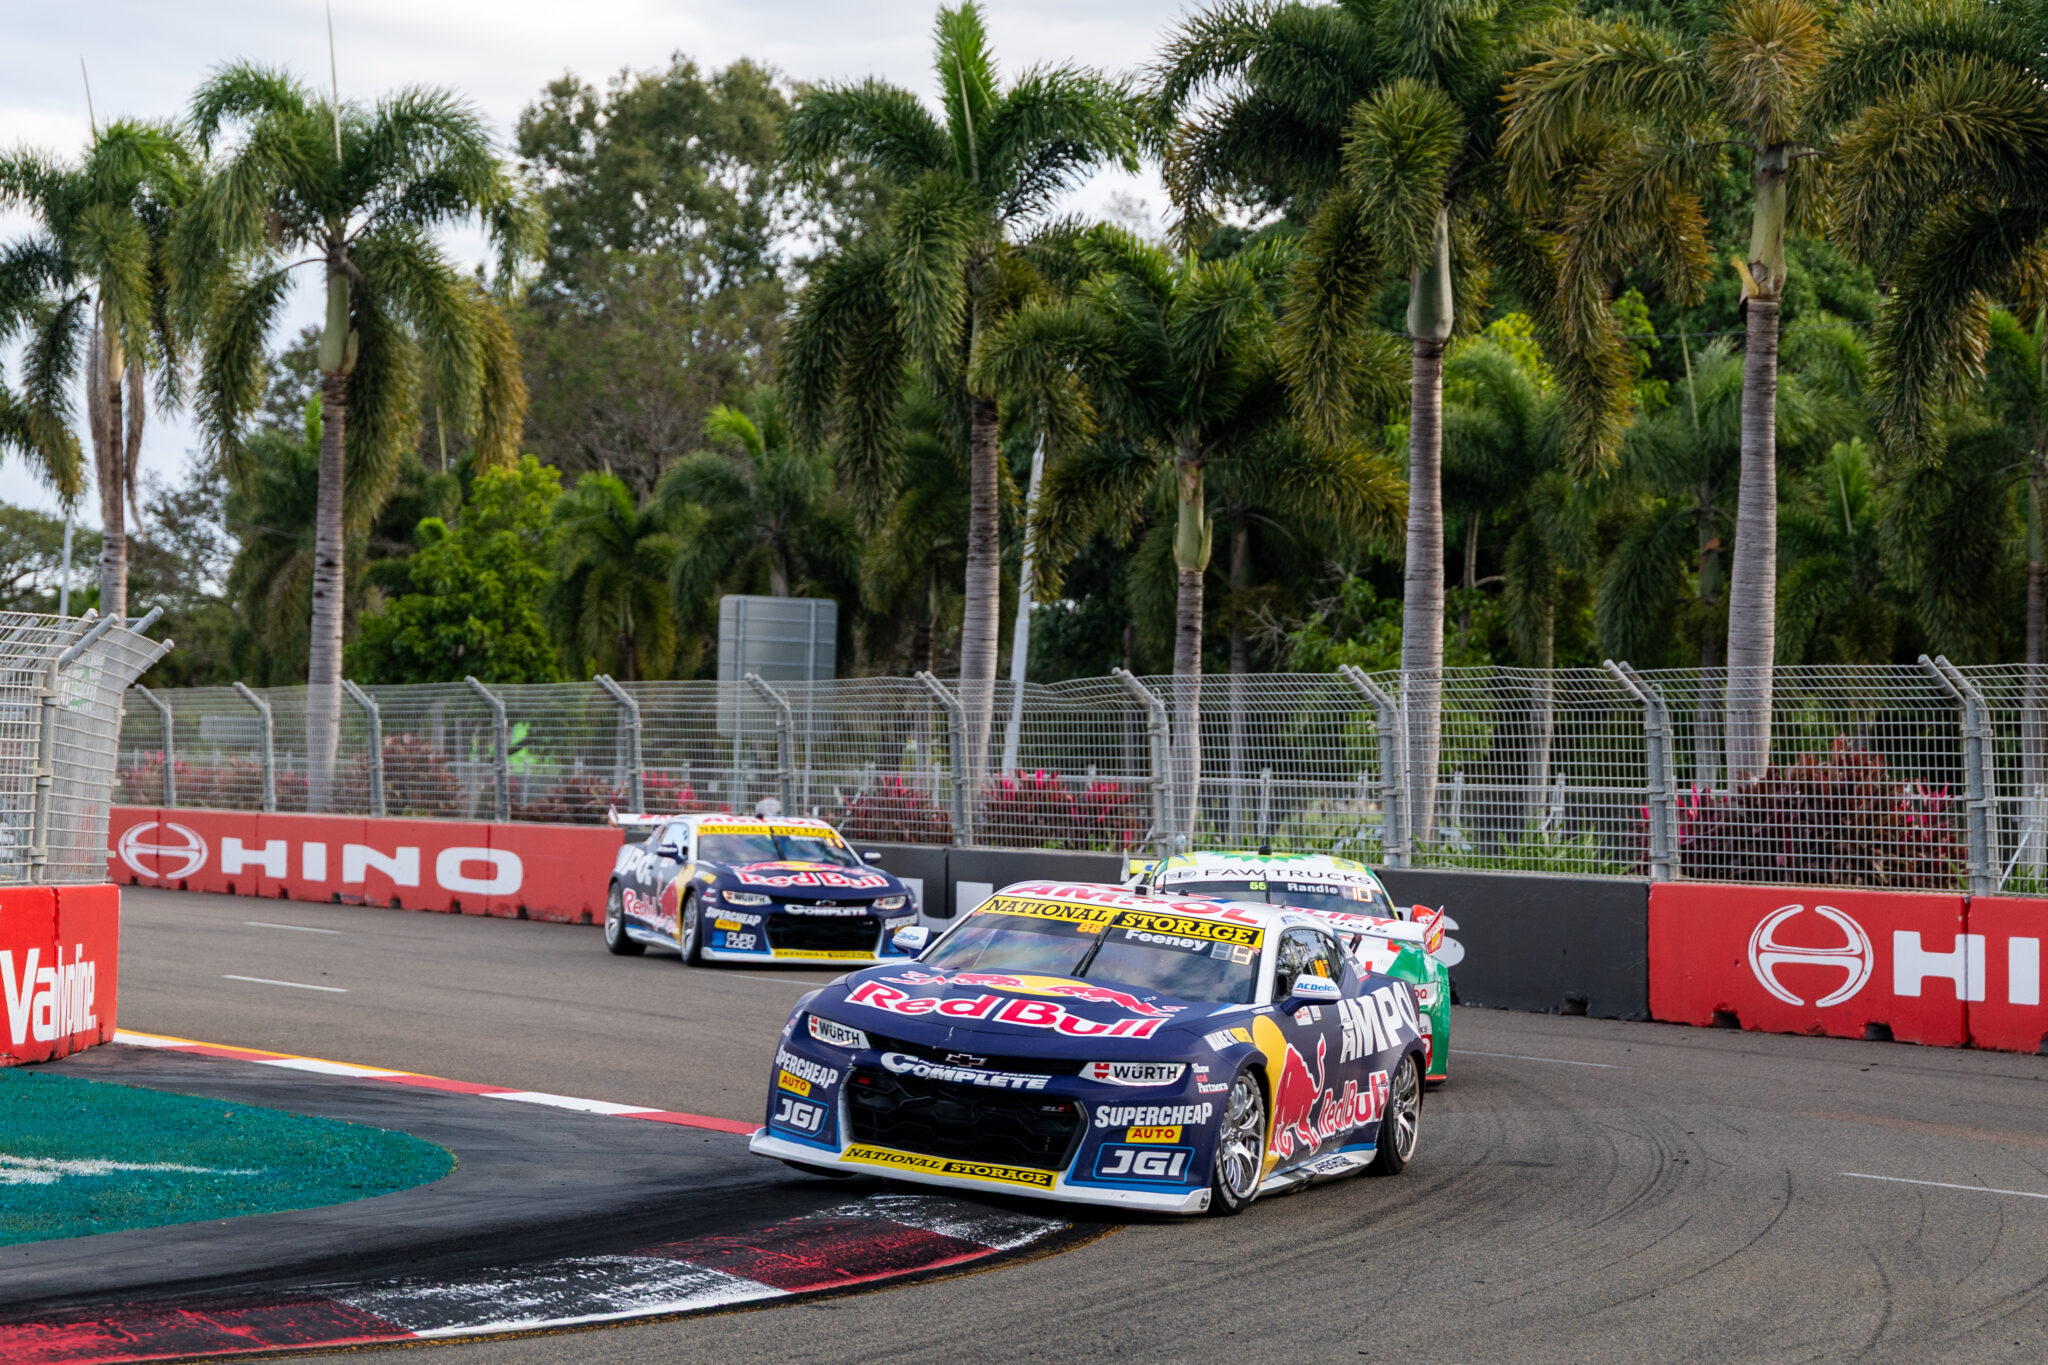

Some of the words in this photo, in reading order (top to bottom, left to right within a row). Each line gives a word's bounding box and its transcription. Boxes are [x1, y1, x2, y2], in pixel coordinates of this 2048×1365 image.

[221, 837, 523, 895] HINO
[1205, 869, 1266, 877] FAW
[1271, 869, 1371, 885] TRUCKS
[734, 872, 821, 888] Red
[816, 872, 890, 889] Bull
[1287, 883, 1339, 895] Randle
[985, 899, 1110, 922] NATIONAL
[1122, 912, 1253, 944] STORAGE
[1076, 922, 1103, 935] 88
[1330, 920, 1388, 933] uels
[1125, 929, 1210, 951] Feeney
[1296, 982, 1337, 992] ACDelco
[844, 981, 1000, 1020] Red
[992, 999, 1170, 1039] Bull
[1337, 982, 1421, 1064] AMPO
[880, 1052, 1049, 1089] COMPLETE
[782, 1075, 807, 1091] AUTO
[1197, 1083, 1228, 1093] Partners
[774, 1098, 823, 1131] JGI
[1094, 1102, 1213, 1128] SUPERCHEAP
[1318, 1080, 1350, 1138] Red
[1344, 1070, 1390, 1132] Bull
[1132, 1129, 1175, 1139] AUTO
[846, 1148, 941, 1169] NATIONAL
[950, 1163, 1048, 1184] STORAGE
[1101, 1150, 1186, 1176] JGI
